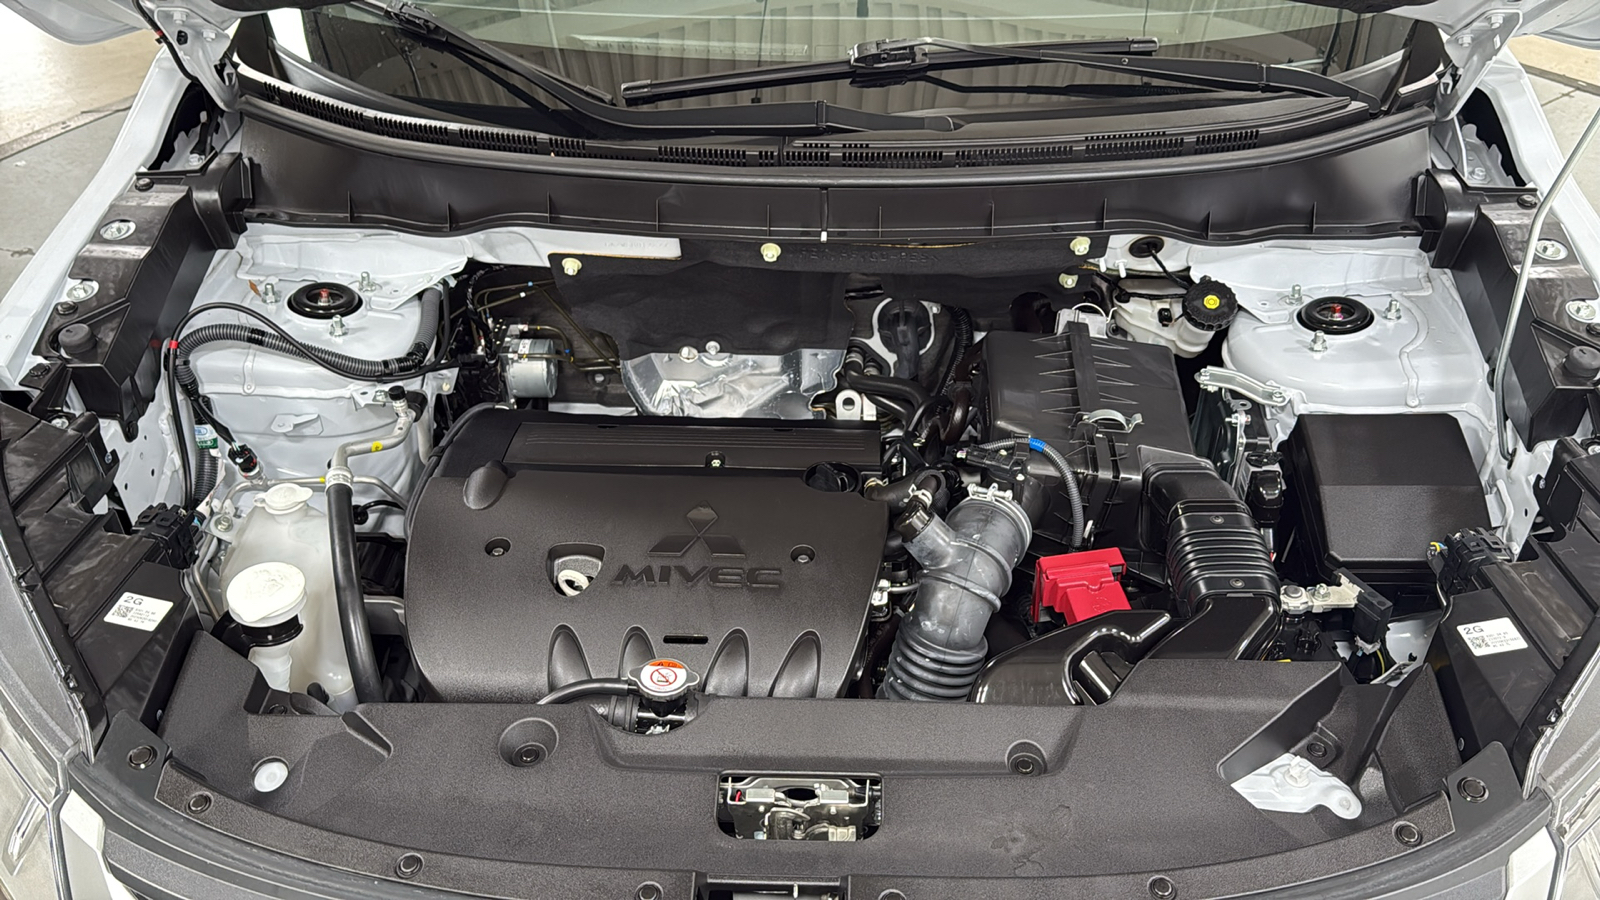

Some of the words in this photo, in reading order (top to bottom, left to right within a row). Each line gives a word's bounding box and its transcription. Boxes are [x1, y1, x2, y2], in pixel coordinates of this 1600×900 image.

[611, 564, 782, 589] MIVEC
[123, 595, 144, 606] 2G
[1463, 625, 1484, 635] 2G
